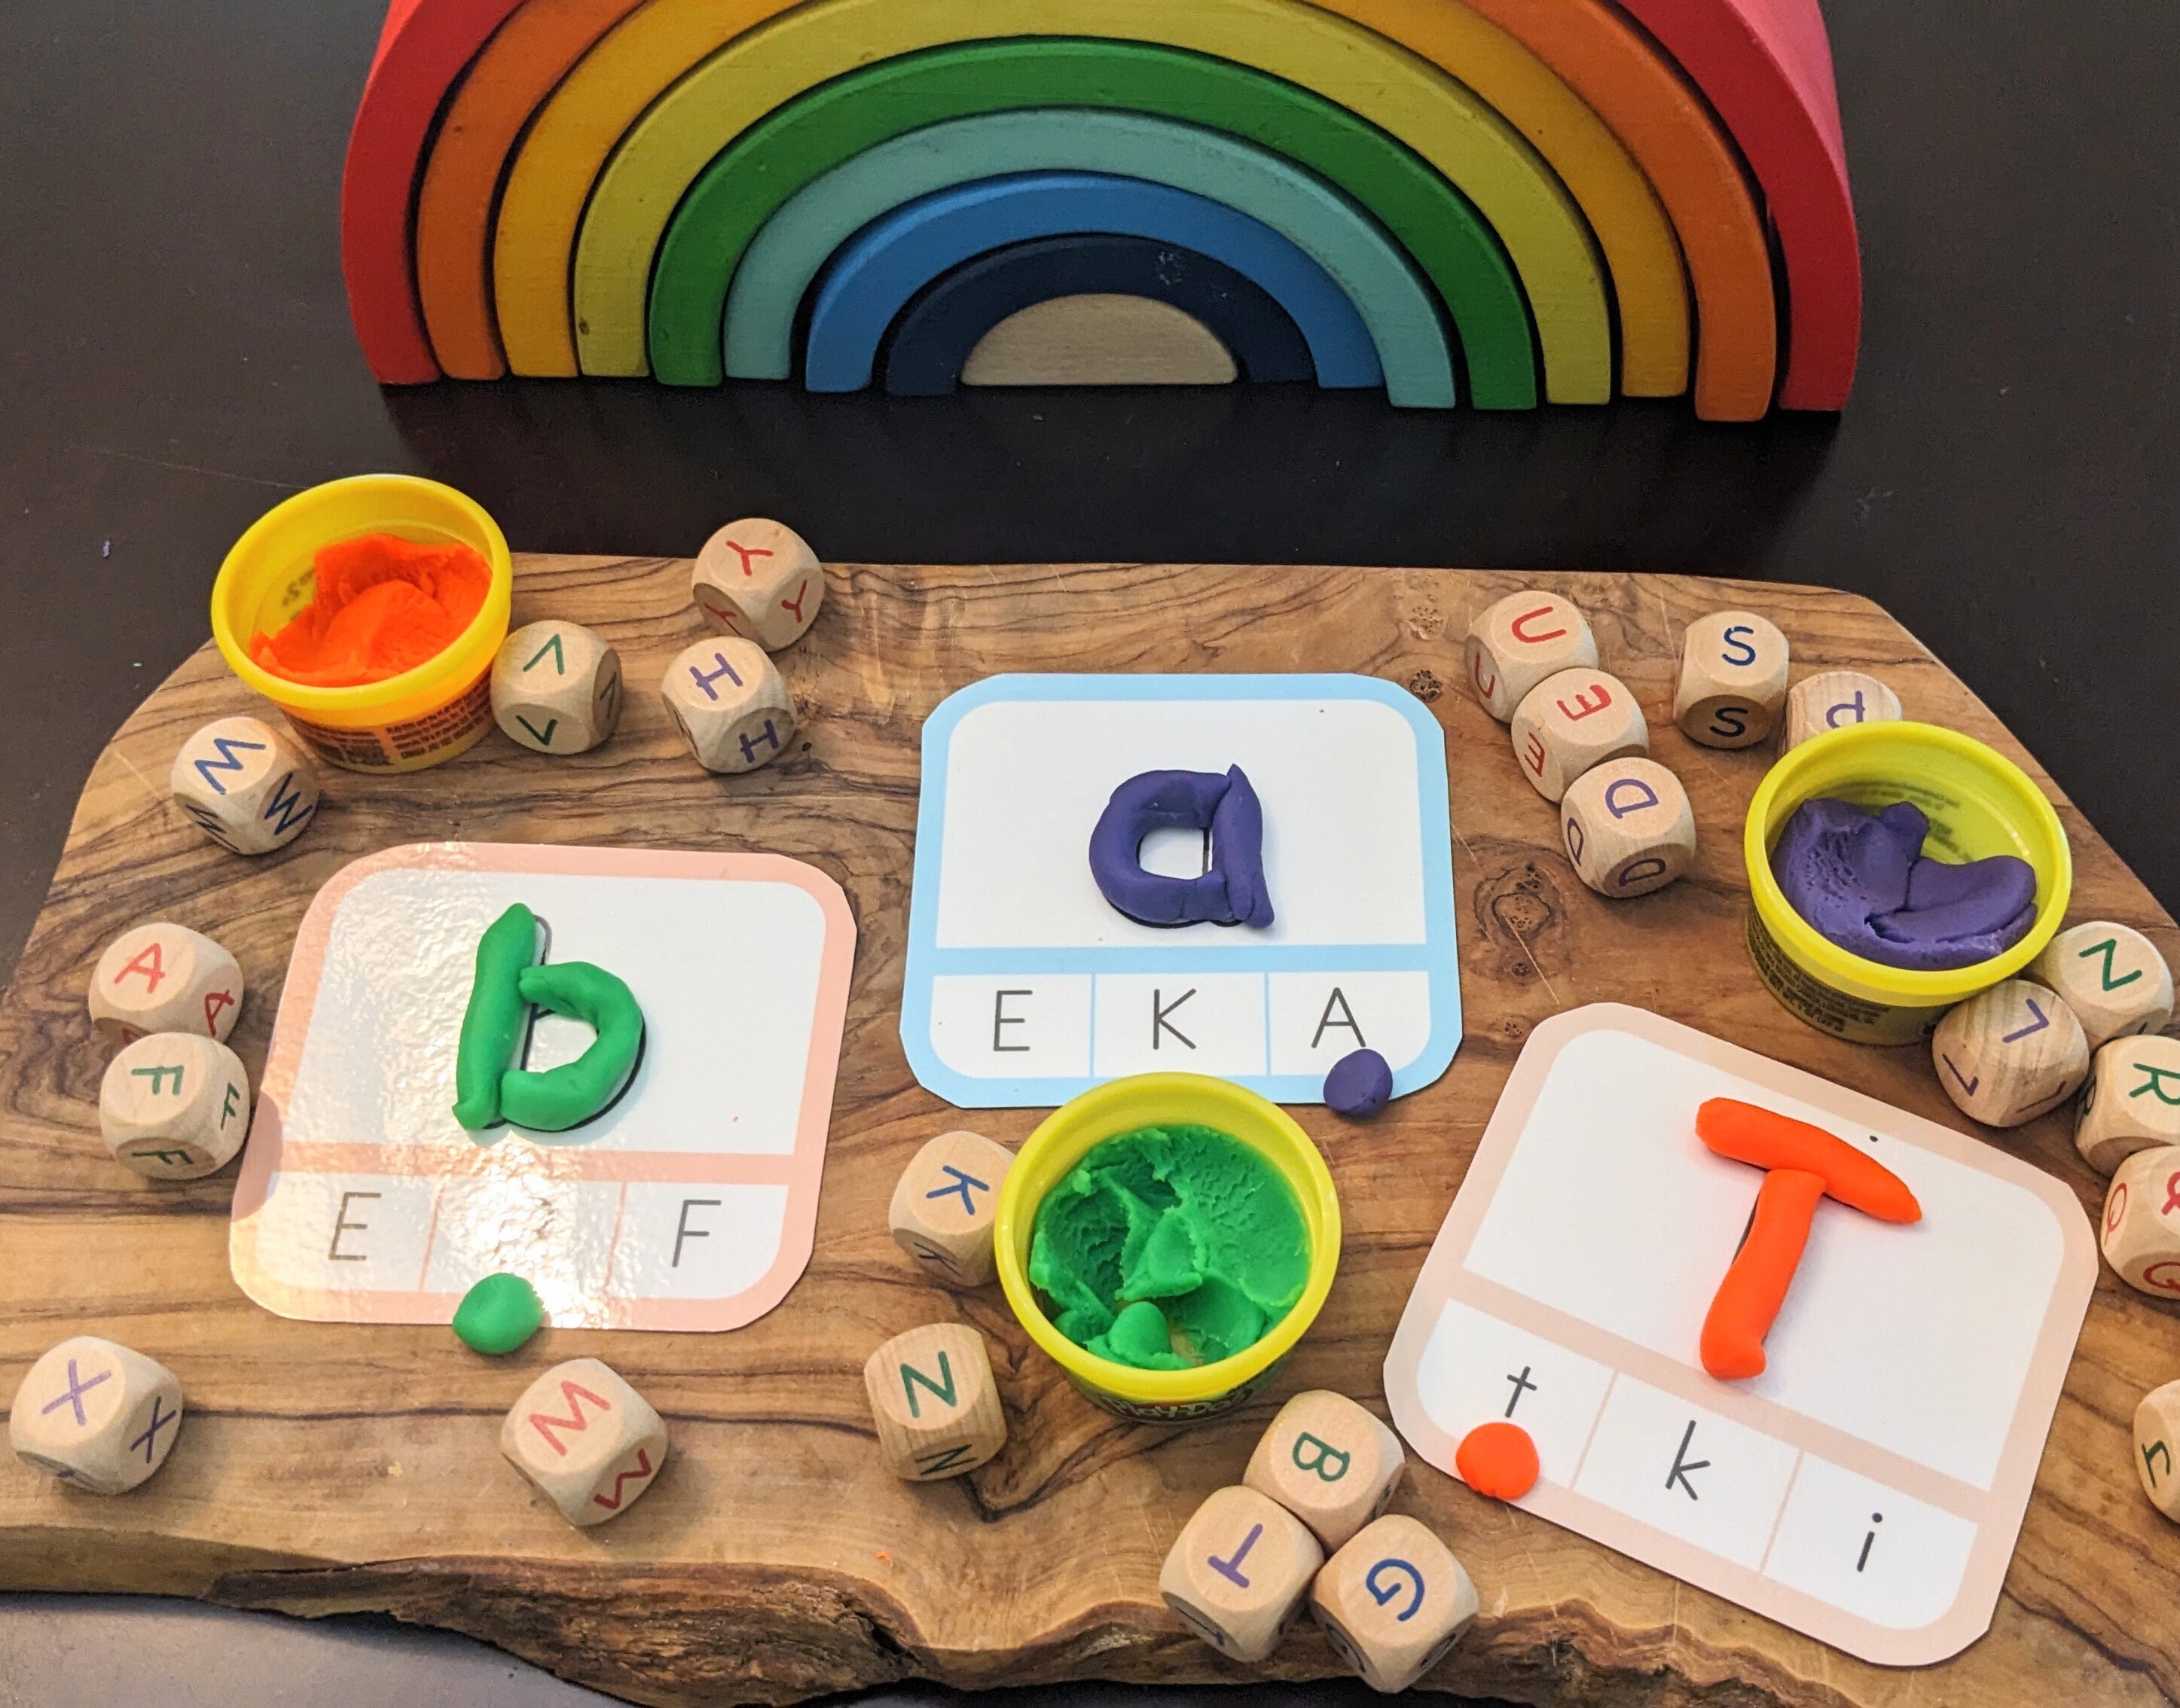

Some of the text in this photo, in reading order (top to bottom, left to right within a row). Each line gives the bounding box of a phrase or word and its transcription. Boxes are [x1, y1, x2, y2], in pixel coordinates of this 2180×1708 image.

[1089, 764, 1275, 929] a
[452, 902, 645, 1132] b
[993, 987, 1367, 1053] E K A
[328, 1191, 722, 1268] E F
[1695, 1096, 1923, 1380] T
[1507, 1366, 1883, 1572] t k i
